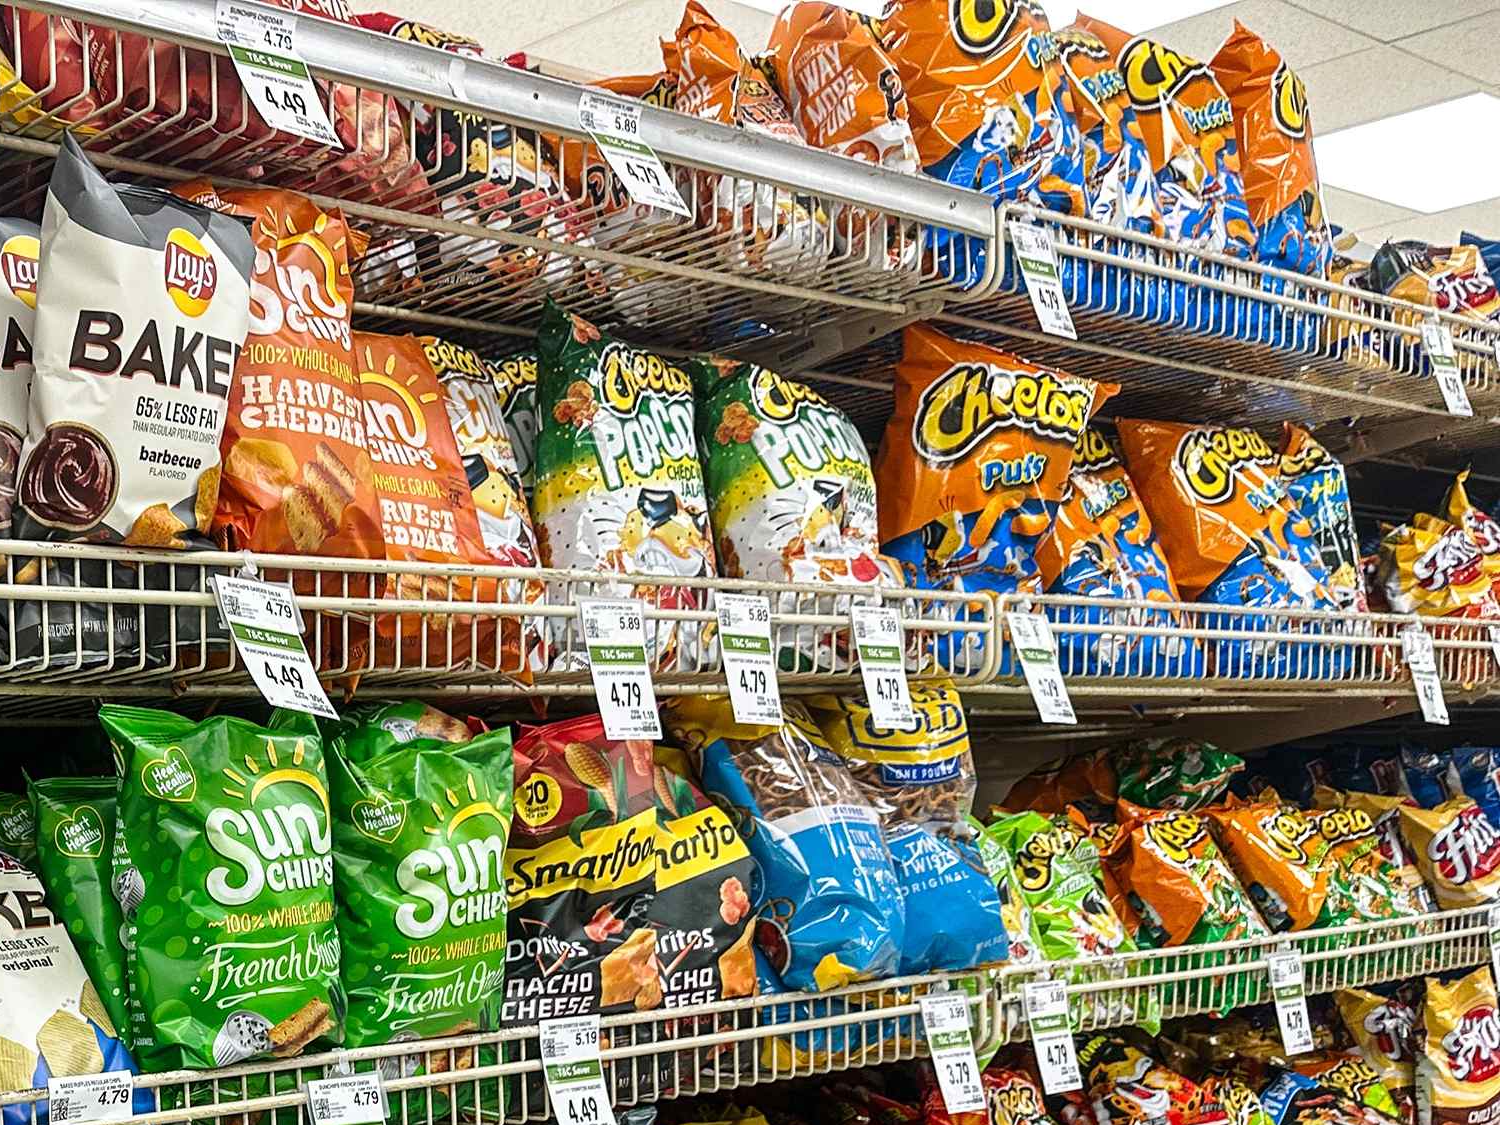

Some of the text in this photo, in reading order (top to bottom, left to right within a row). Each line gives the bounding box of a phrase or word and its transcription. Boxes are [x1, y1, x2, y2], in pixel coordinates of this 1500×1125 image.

[264, 30, 293, 50] 4.79
[801, 42, 841, 97] WAY
[265, 86, 307, 116] 4.49
[806, 66, 854, 127] MORE
[614, 116, 637, 134] 5.89
[626, 162, 660, 186] 4.79
[166, 251, 216, 299] Lay's
[1039, 288, 1059, 310] 4.79
[136, 396, 218, 430] 65% LESS FAT
[922, 365, 1090, 451] Cheetos
[140, 445, 201, 469] barbecue
[266, 601, 292, 619] 4.79
[749, 608, 768, 622] 5.89
[619, 617, 640, 630] 5.89
[880, 620, 897, 633] 5.89
[264, 661, 304, 690] 4.49
[740, 670, 766, 694] 4.79
[611, 683, 641, 707] 4.79
[877, 678, 899, 700] 4.79
[153, 762, 182, 784] Heart
[205, 800, 331, 906] Sun
[902, 850, 957, 878] TWISTS
[898, 870, 969, 897] ORIGINAL
[3, 956, 53, 971] original
[506, 972, 593, 998] NACHO
[501, 995, 595, 1021] CHEESE
[1047, 1044, 1067, 1065] 4.79
[947, 1062, 969, 1084] 3.79
[98, 1089, 129, 1106] 4.79
[354, 1091, 379, 1106] 4.79
[569, 1096, 598, 1123] 4.49
